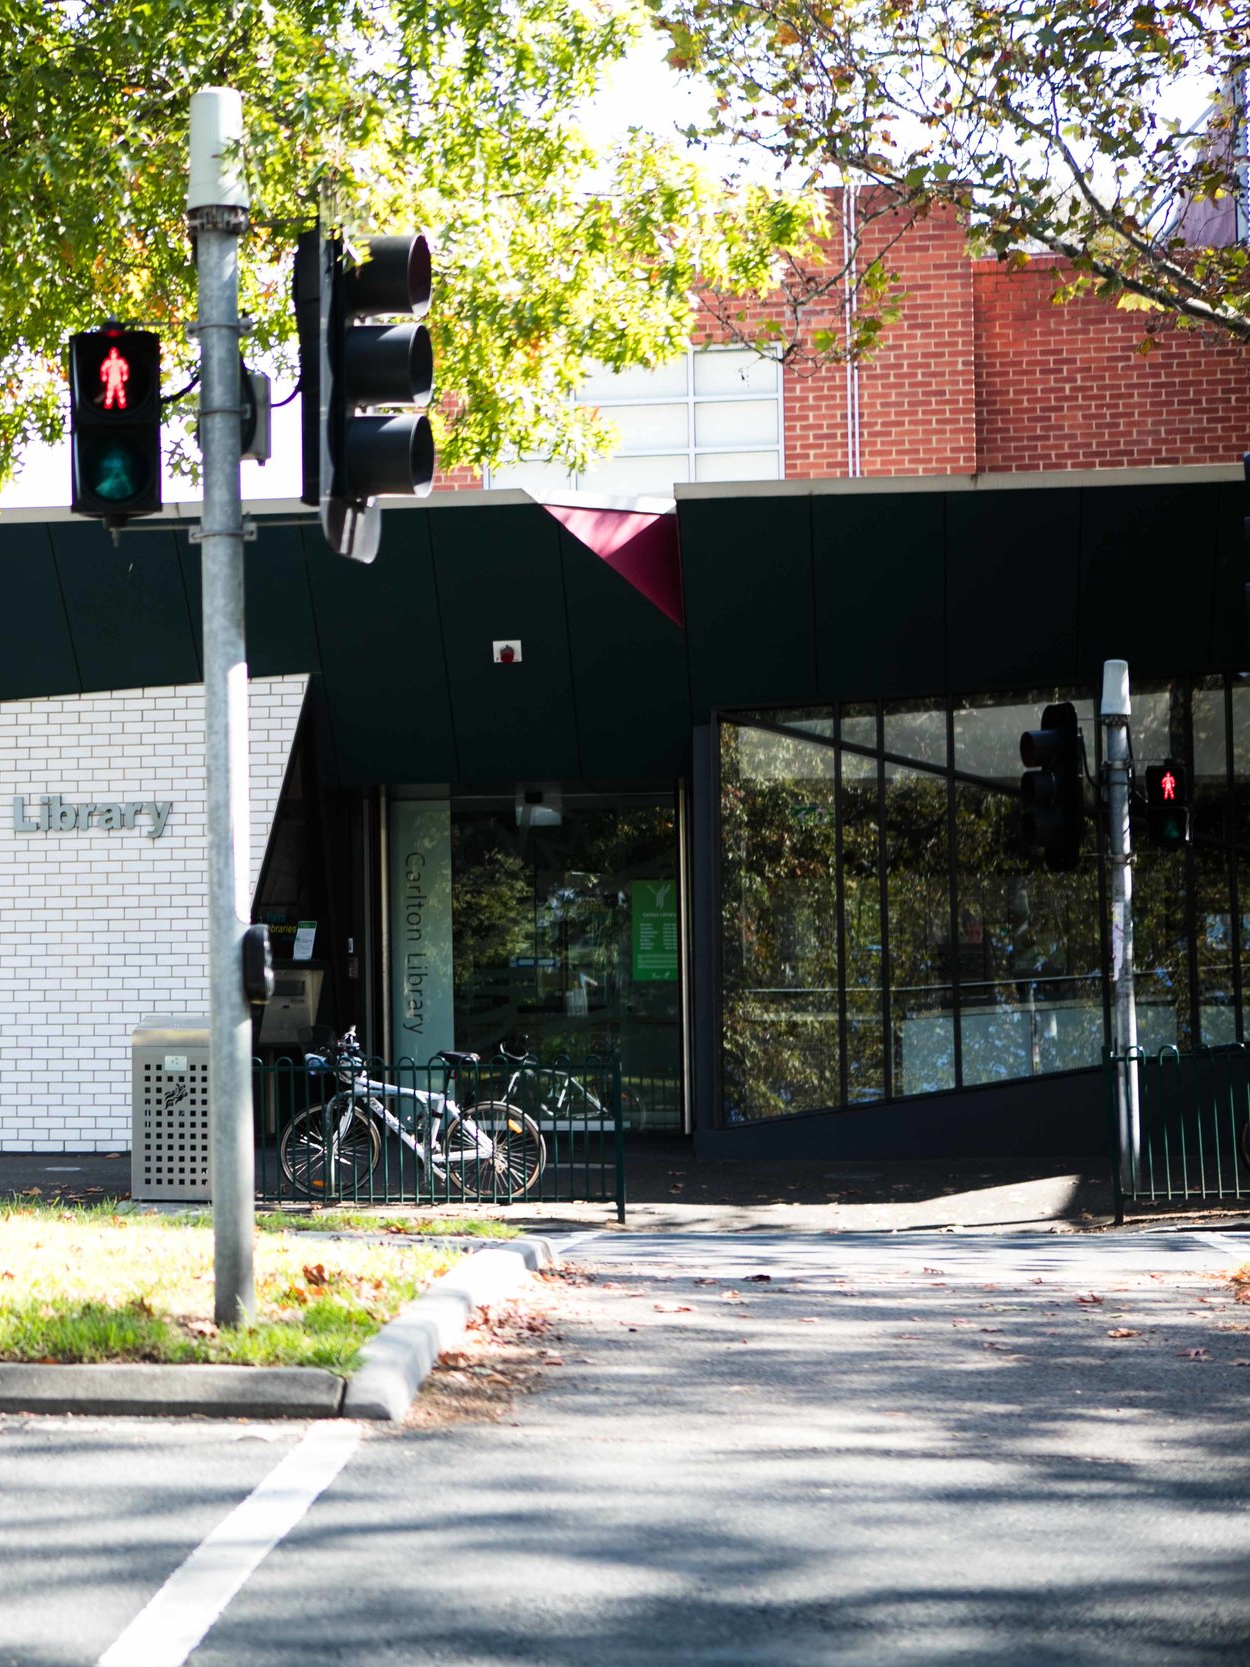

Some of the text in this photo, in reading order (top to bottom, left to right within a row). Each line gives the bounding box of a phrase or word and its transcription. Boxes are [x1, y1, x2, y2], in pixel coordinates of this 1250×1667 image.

[13, 796, 173, 838] Library
[403, 852, 428, 1035] Carlton Library
